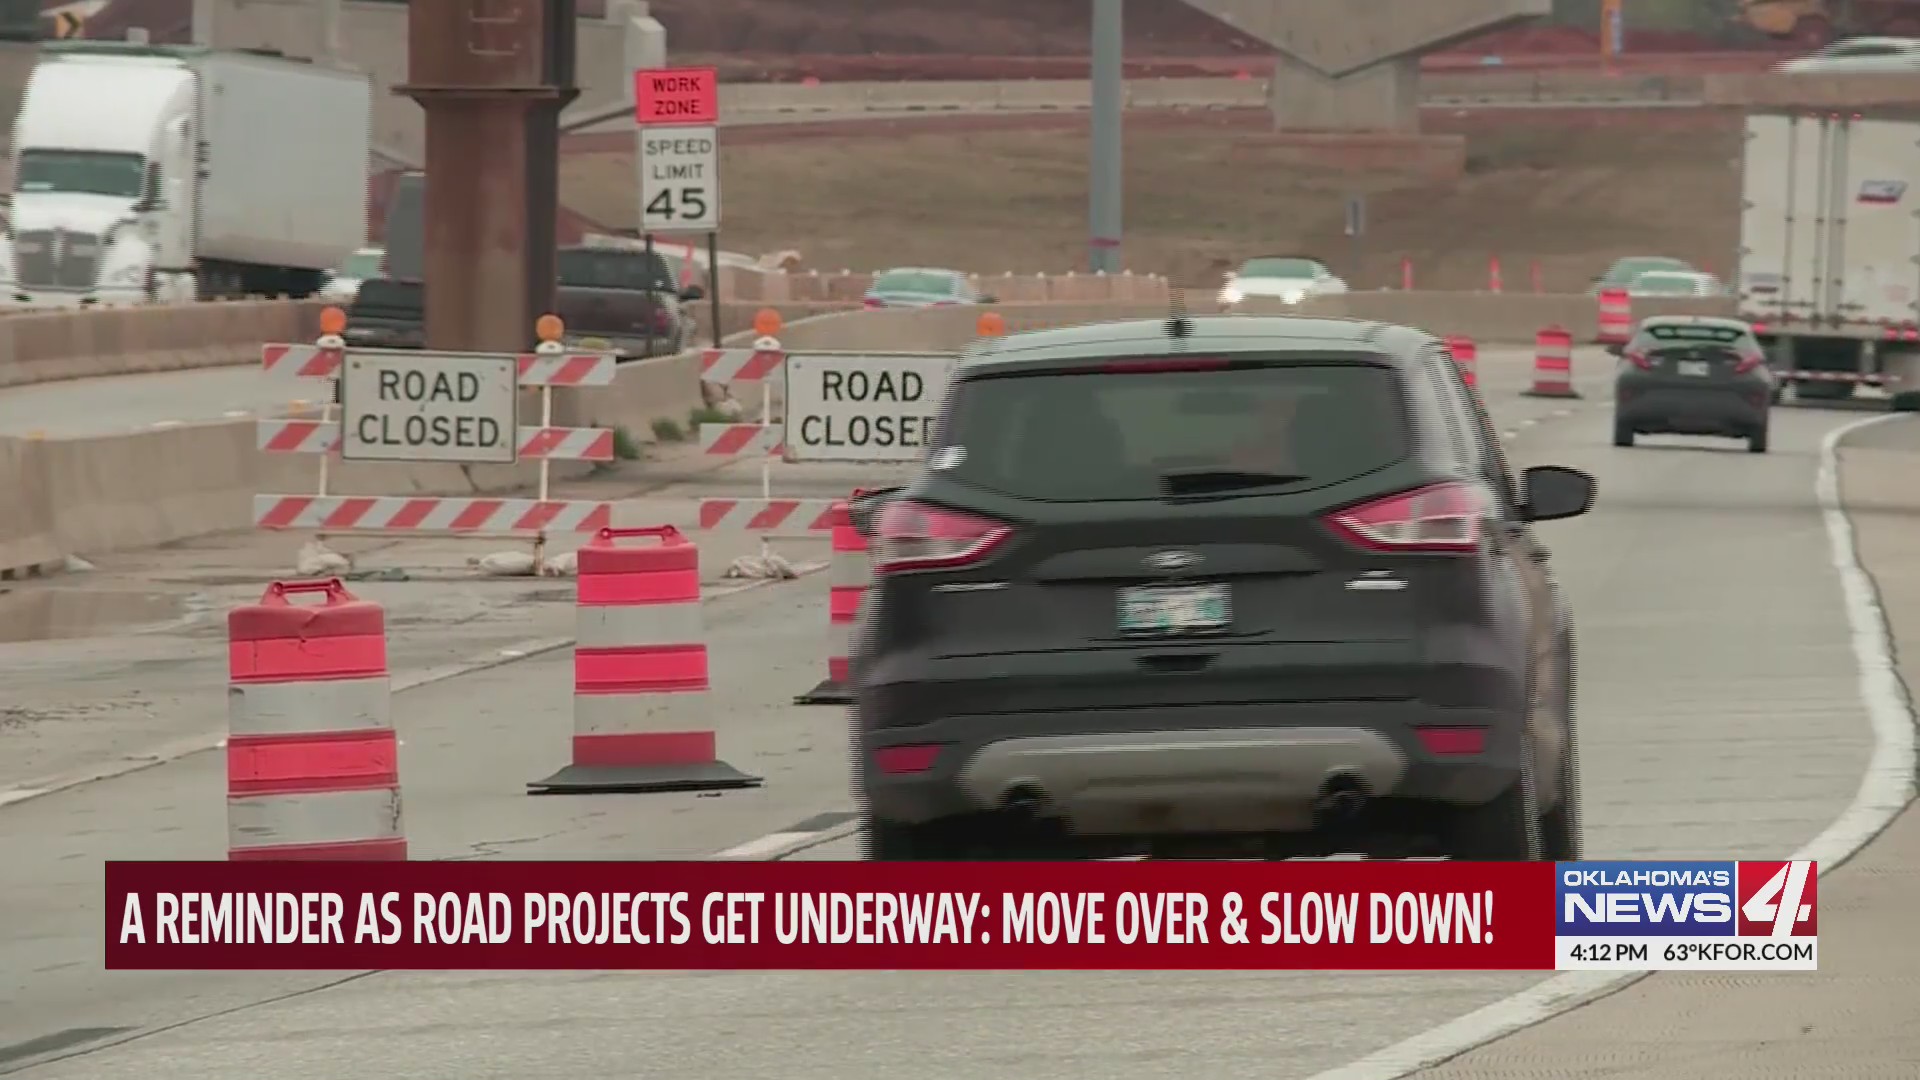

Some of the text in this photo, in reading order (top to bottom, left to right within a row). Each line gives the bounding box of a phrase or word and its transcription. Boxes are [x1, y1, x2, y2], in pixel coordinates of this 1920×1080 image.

[652, 77, 702, 93] WORK
[654, 99, 702, 115] ZONE
[646, 138, 712, 156] SPEED
[653, 163, 704, 180] LIMIT
[646, 187, 707, 220] 45
[379, 369, 479, 402] ROAD
[822, 370, 923, 401] ROAD
[358, 413, 499, 448] CLOSED
